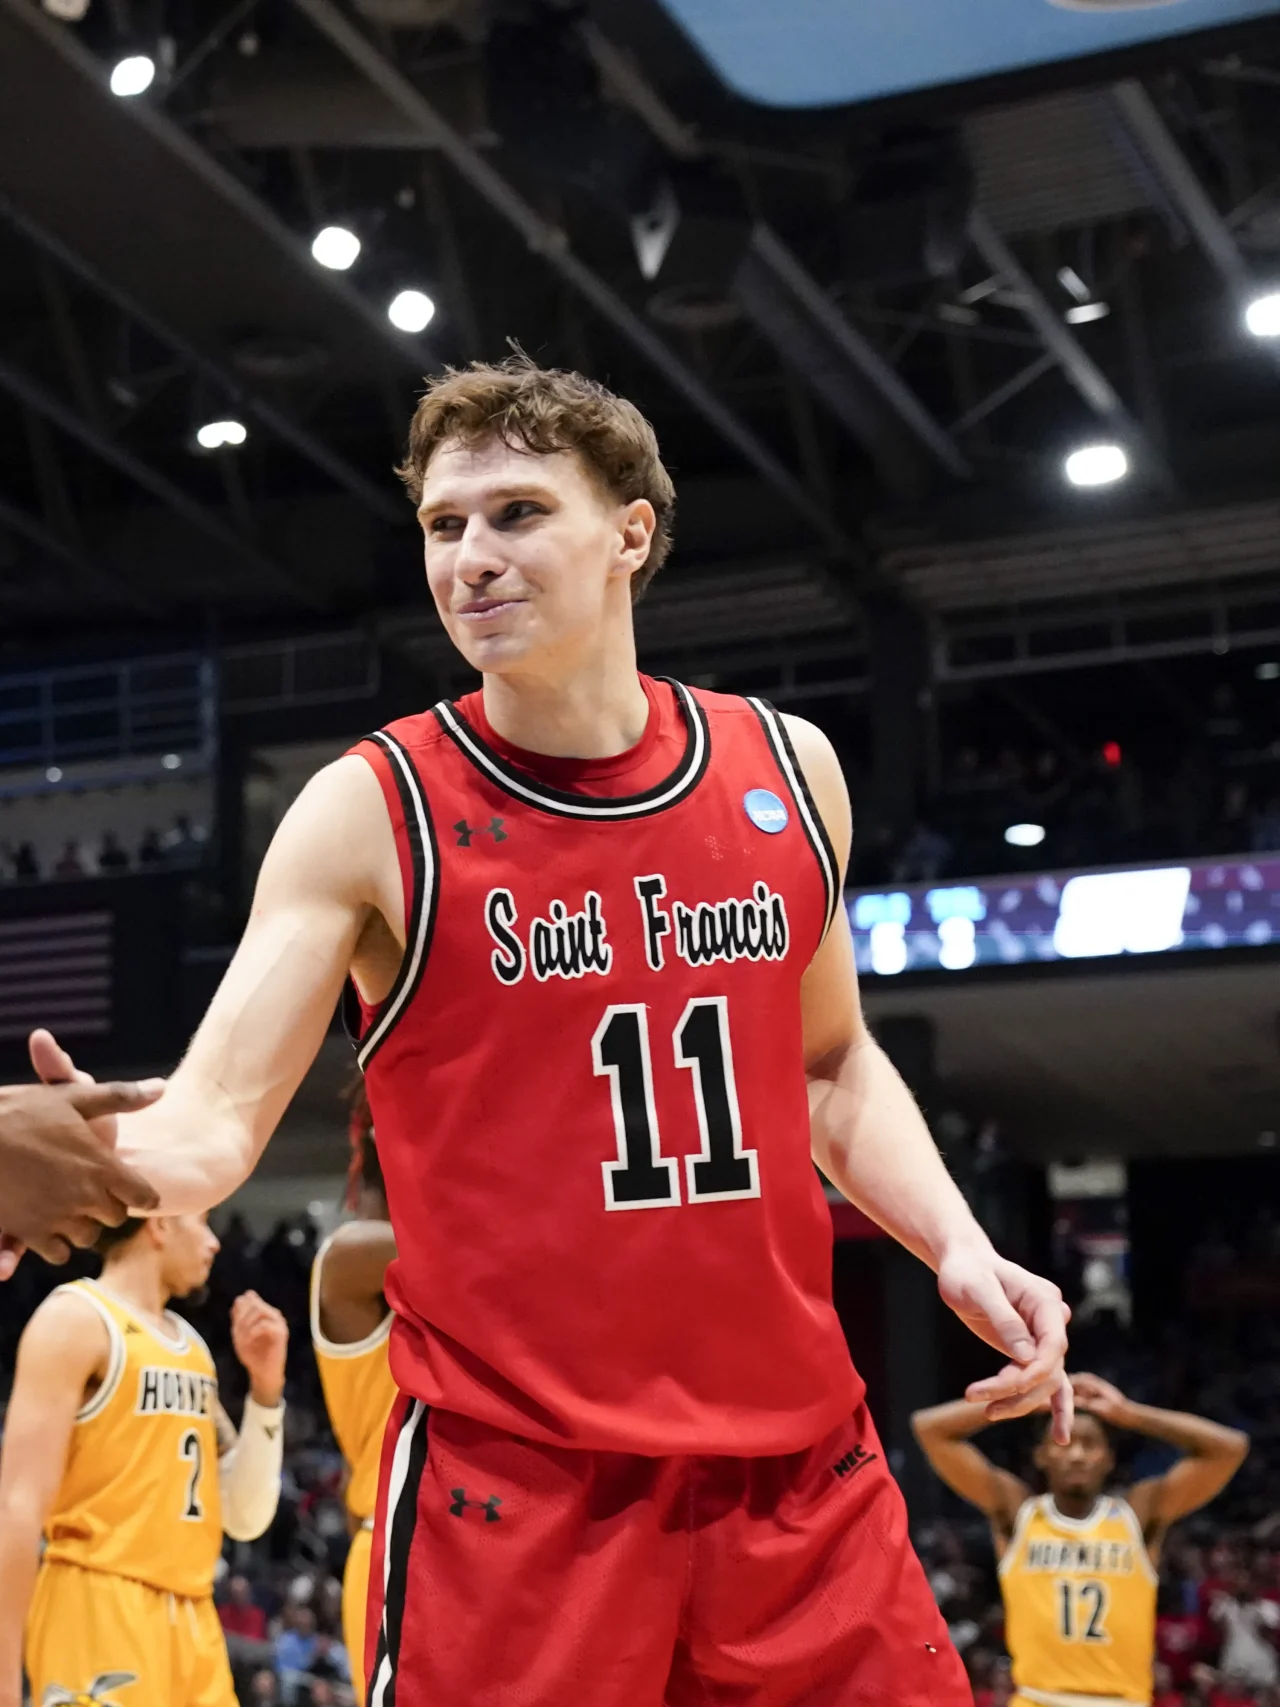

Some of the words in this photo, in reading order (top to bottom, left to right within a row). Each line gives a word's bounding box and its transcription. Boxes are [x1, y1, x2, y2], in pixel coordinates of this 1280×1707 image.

[485, 887, 613, 986] Saint
[634, 873, 790, 972] Francis
[591, 996, 761, 1211] 11
[177, 1427, 206, 1522] 2
[833, 1443, 869, 1478] NEC
[1022, 1541, 1134, 1576] HORNETS
[1053, 1577, 1113, 1646] 12
